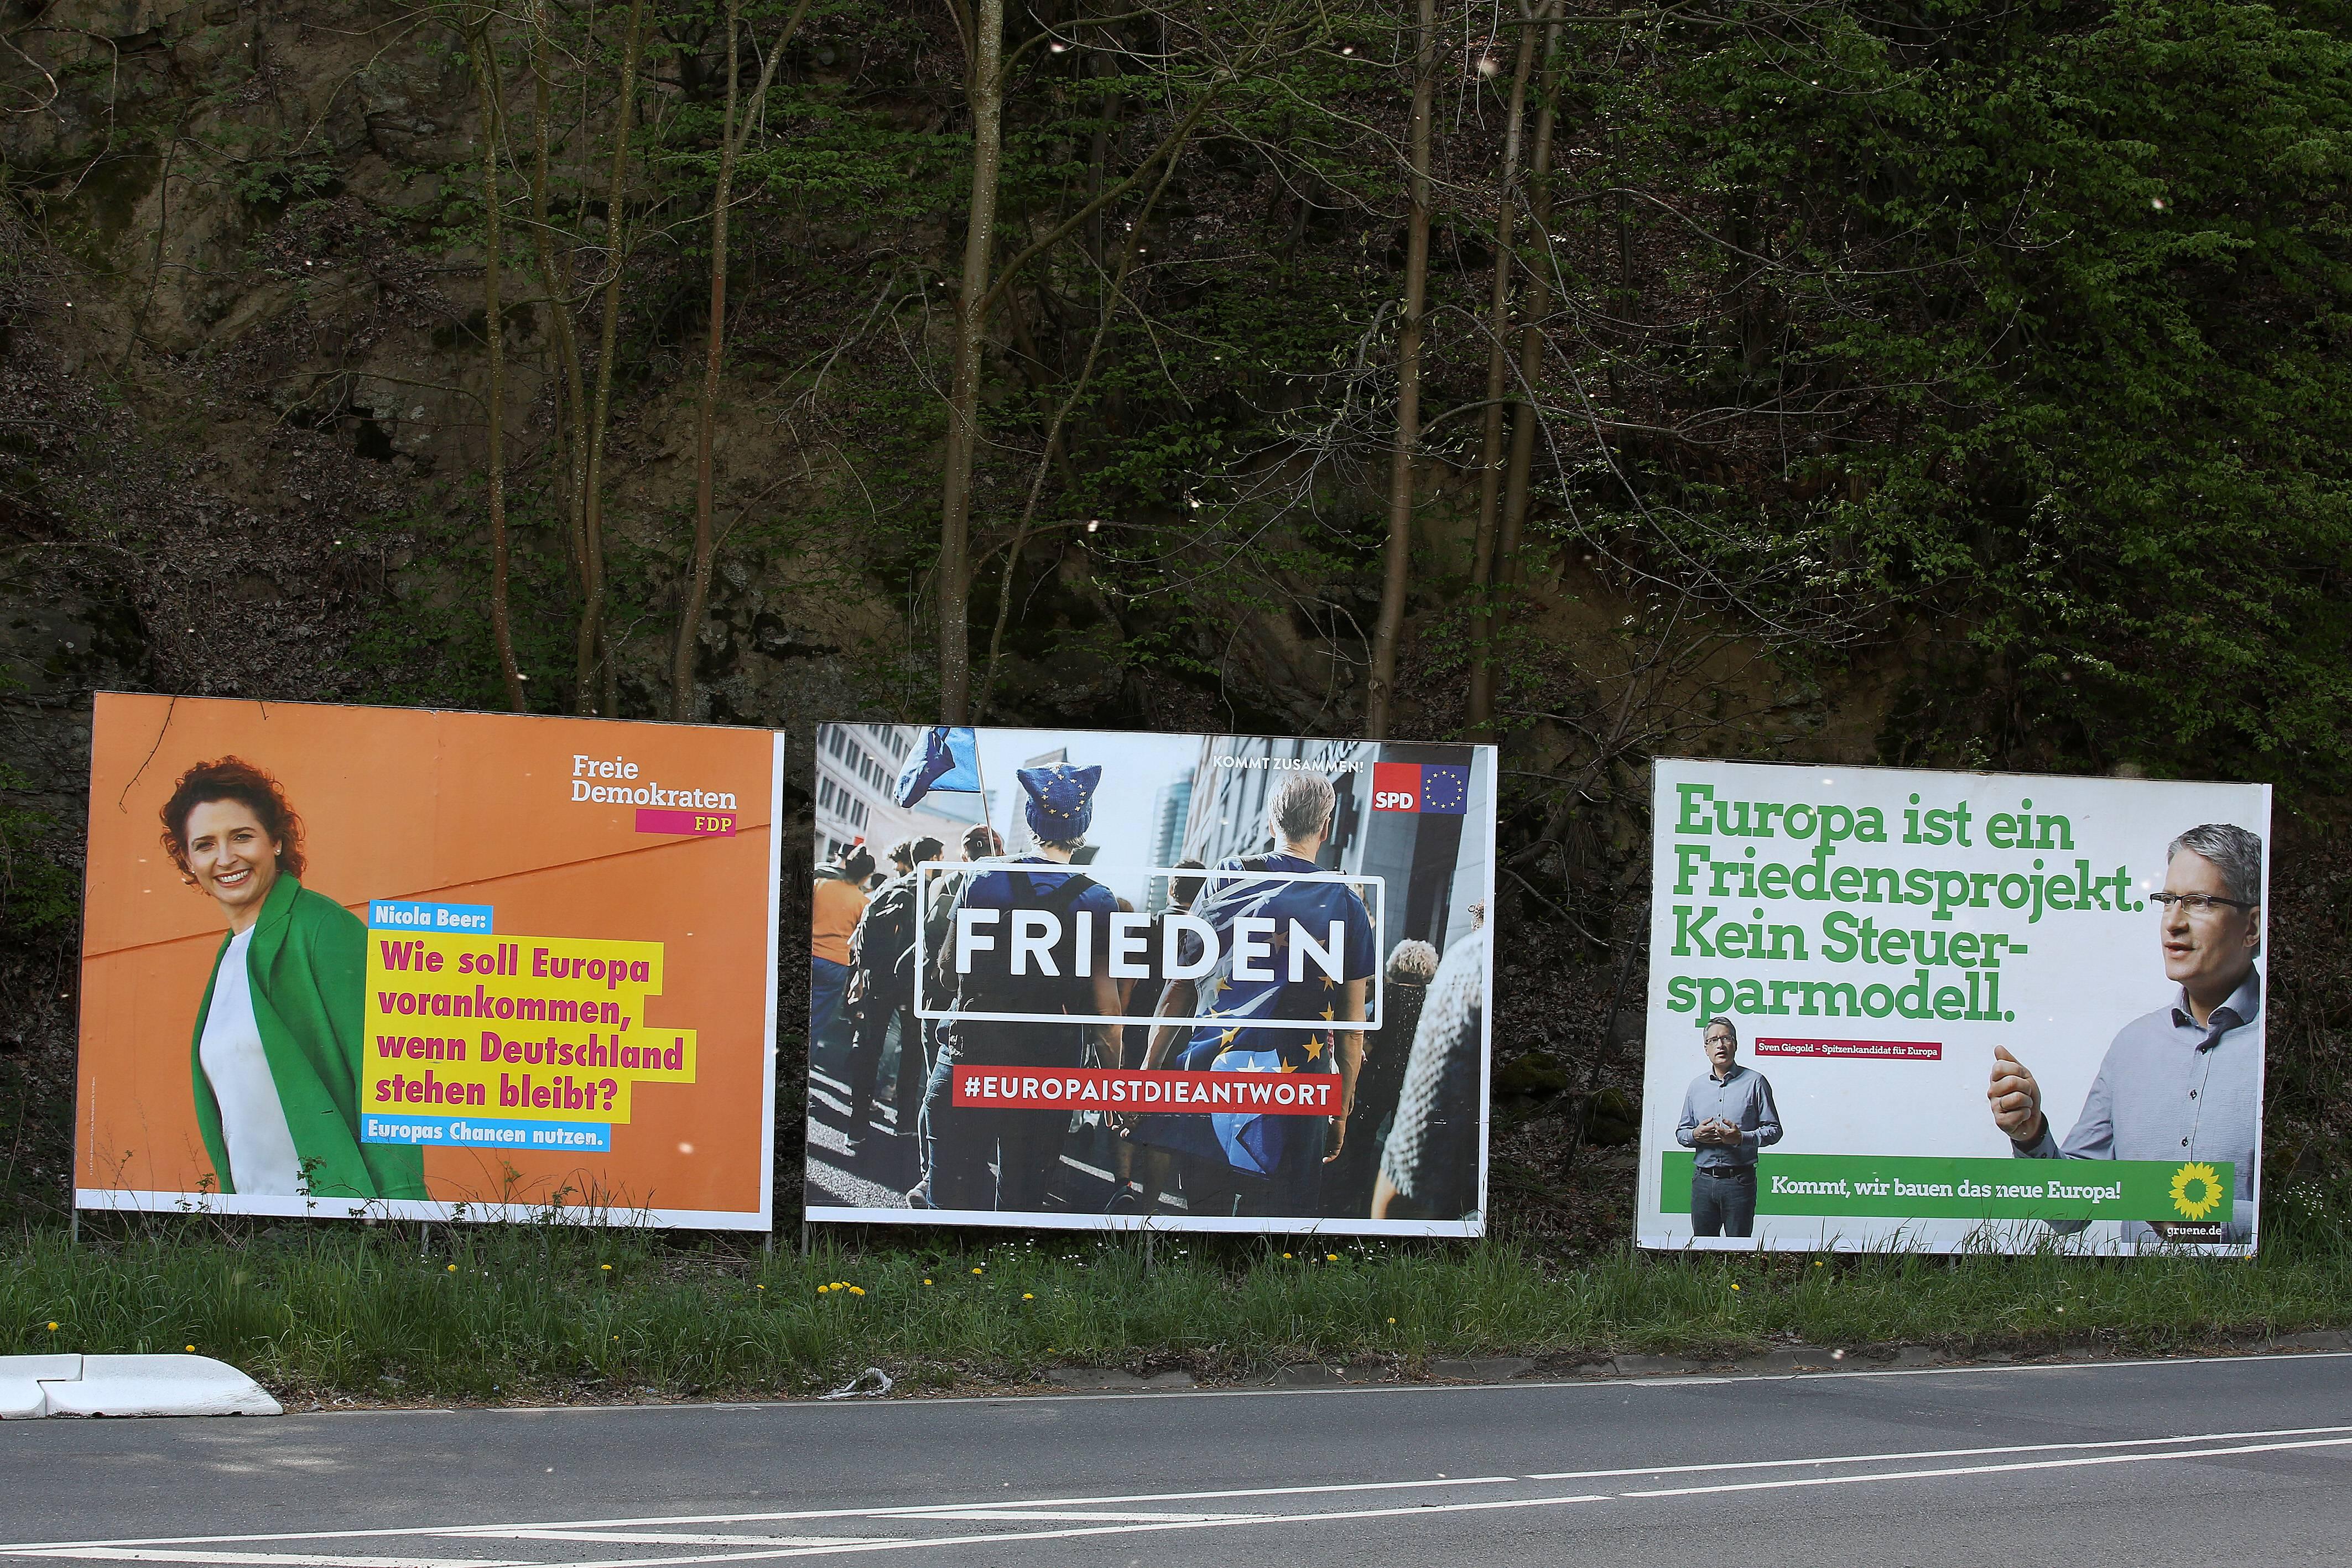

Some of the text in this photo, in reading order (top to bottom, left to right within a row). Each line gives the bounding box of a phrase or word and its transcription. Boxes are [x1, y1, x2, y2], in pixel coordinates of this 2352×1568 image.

[573, 754, 638, 779] Freie
[1213, 755, 1364, 774] KOMMT ZUSAMMEN!
[571, 780, 737, 809] Demokraten
[1375, 791, 1414, 809] SPD
[694, 816, 732, 832] FDP
[1674, 783, 2074, 855] Europa ist ein
[1673, 844, 2144, 924] Friedensprojekt.
[375, 905, 486, 929] Nicola Beer:
[955, 908, 1345, 984] FRIEDEN
[1671, 905, 2028, 968] Kein Steuer-
[380, 940, 650, 990] Wie soll Europa
[378, 984, 632, 1032] vorankommen,
[1667, 969, 2015, 1028] sparmodell.
[376, 1030, 684, 1070] wenn Deutschland
[1758, 1043, 1780, 1051] Sven
[1781, 1043, 1814, 1054] Giegold
[1822, 1044, 1892, 1055] Spitzenkandidat
[1892, 1045, 1906, 1054] für
[1907, 1047, 1938, 1058] Europa
[375, 1070, 618, 1111] stehen bleibt?
[964, 1076, 1331, 1106] #EUROPAISTDIEANTWORT
[368, 1119, 603, 1145] Europas Chancen nutzen.
[1771, 1176, 2121, 1204] Kommt, wir bauen das neue Europa!
[2167, 1226, 2222, 1237] gruene.de
